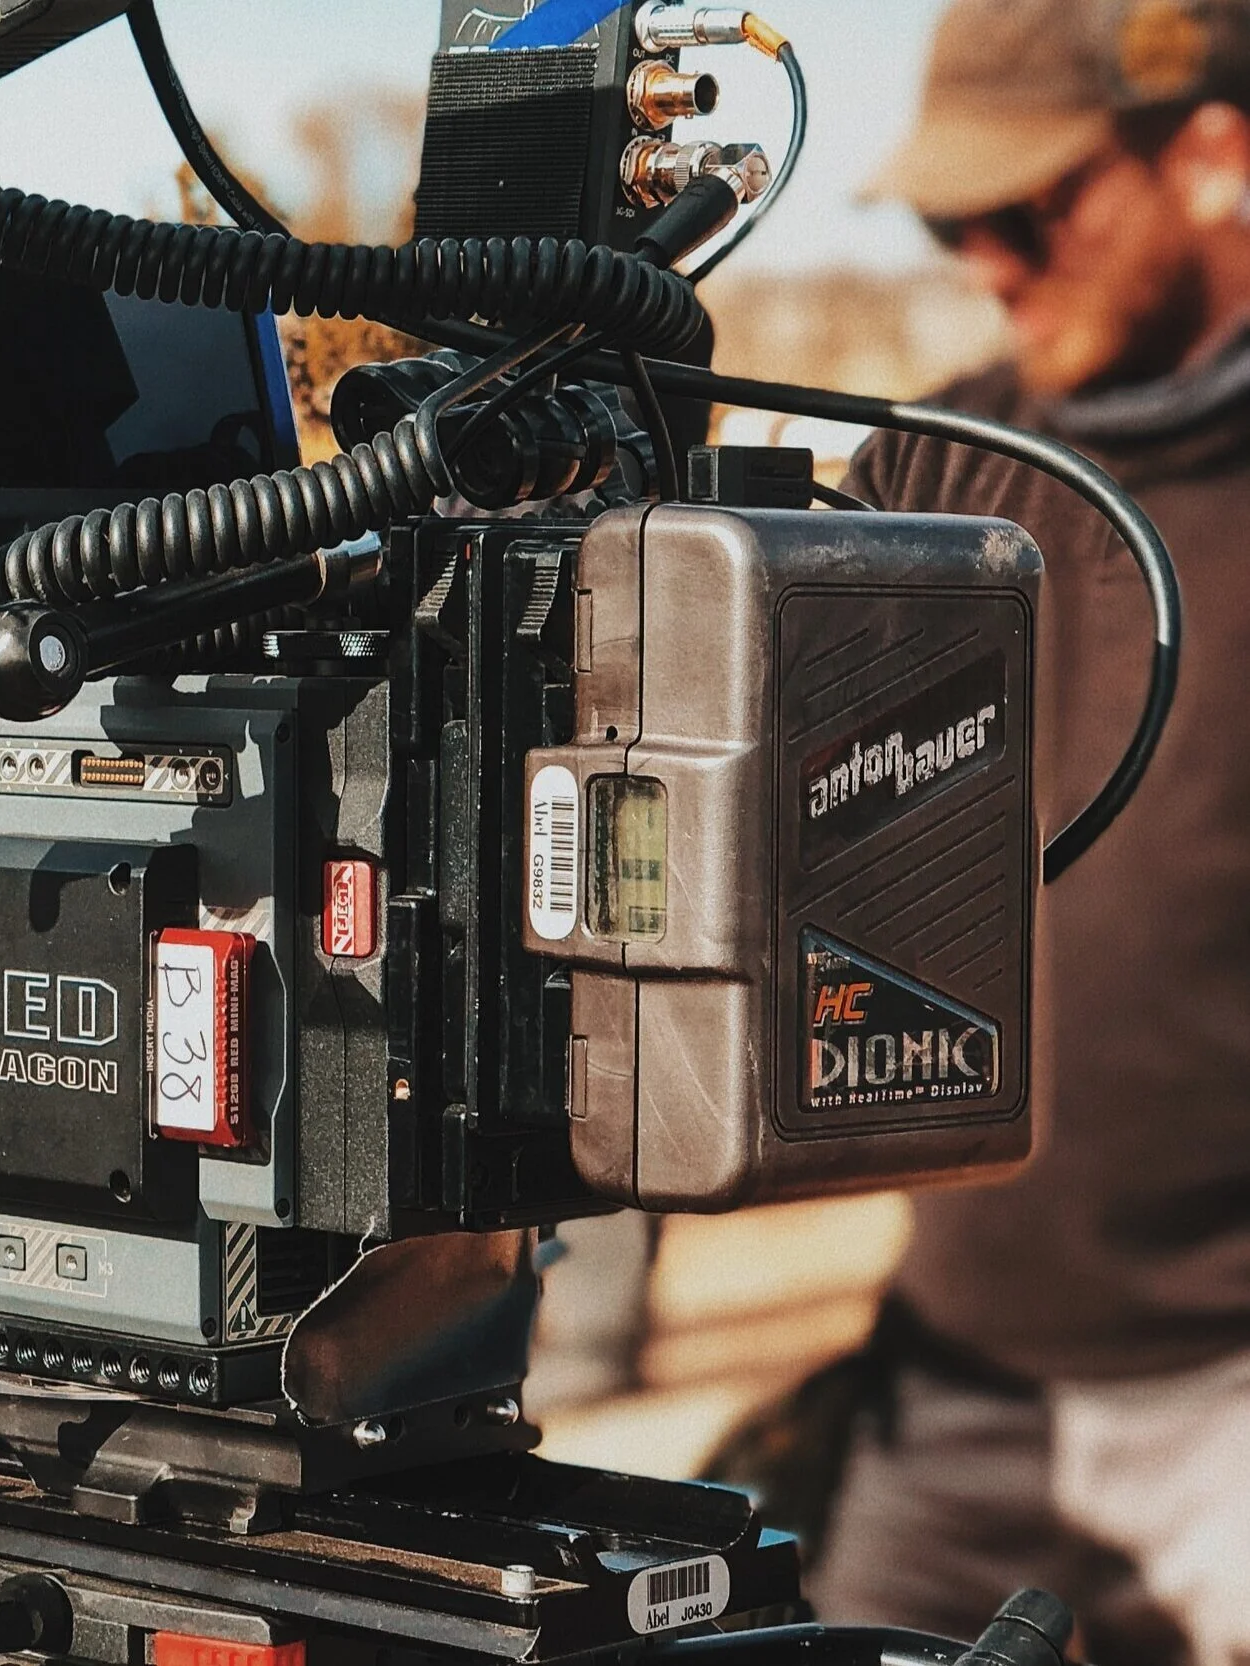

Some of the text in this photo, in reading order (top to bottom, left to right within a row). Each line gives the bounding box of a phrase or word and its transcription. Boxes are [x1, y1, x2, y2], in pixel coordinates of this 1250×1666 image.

[532, 854, 544, 910] G9832
[812, 982, 874, 1028] HC
[146, 999, 154, 1072] INSERT MEDIA
[230, 1037, 239, 1067] RED
[811, 1026, 981, 1090] DIONIC
[230, 1073, 239, 1125] 512GB
[98, 1260, 114, 1277] M3
[645, 1602, 713, 1630] Abel J0430
